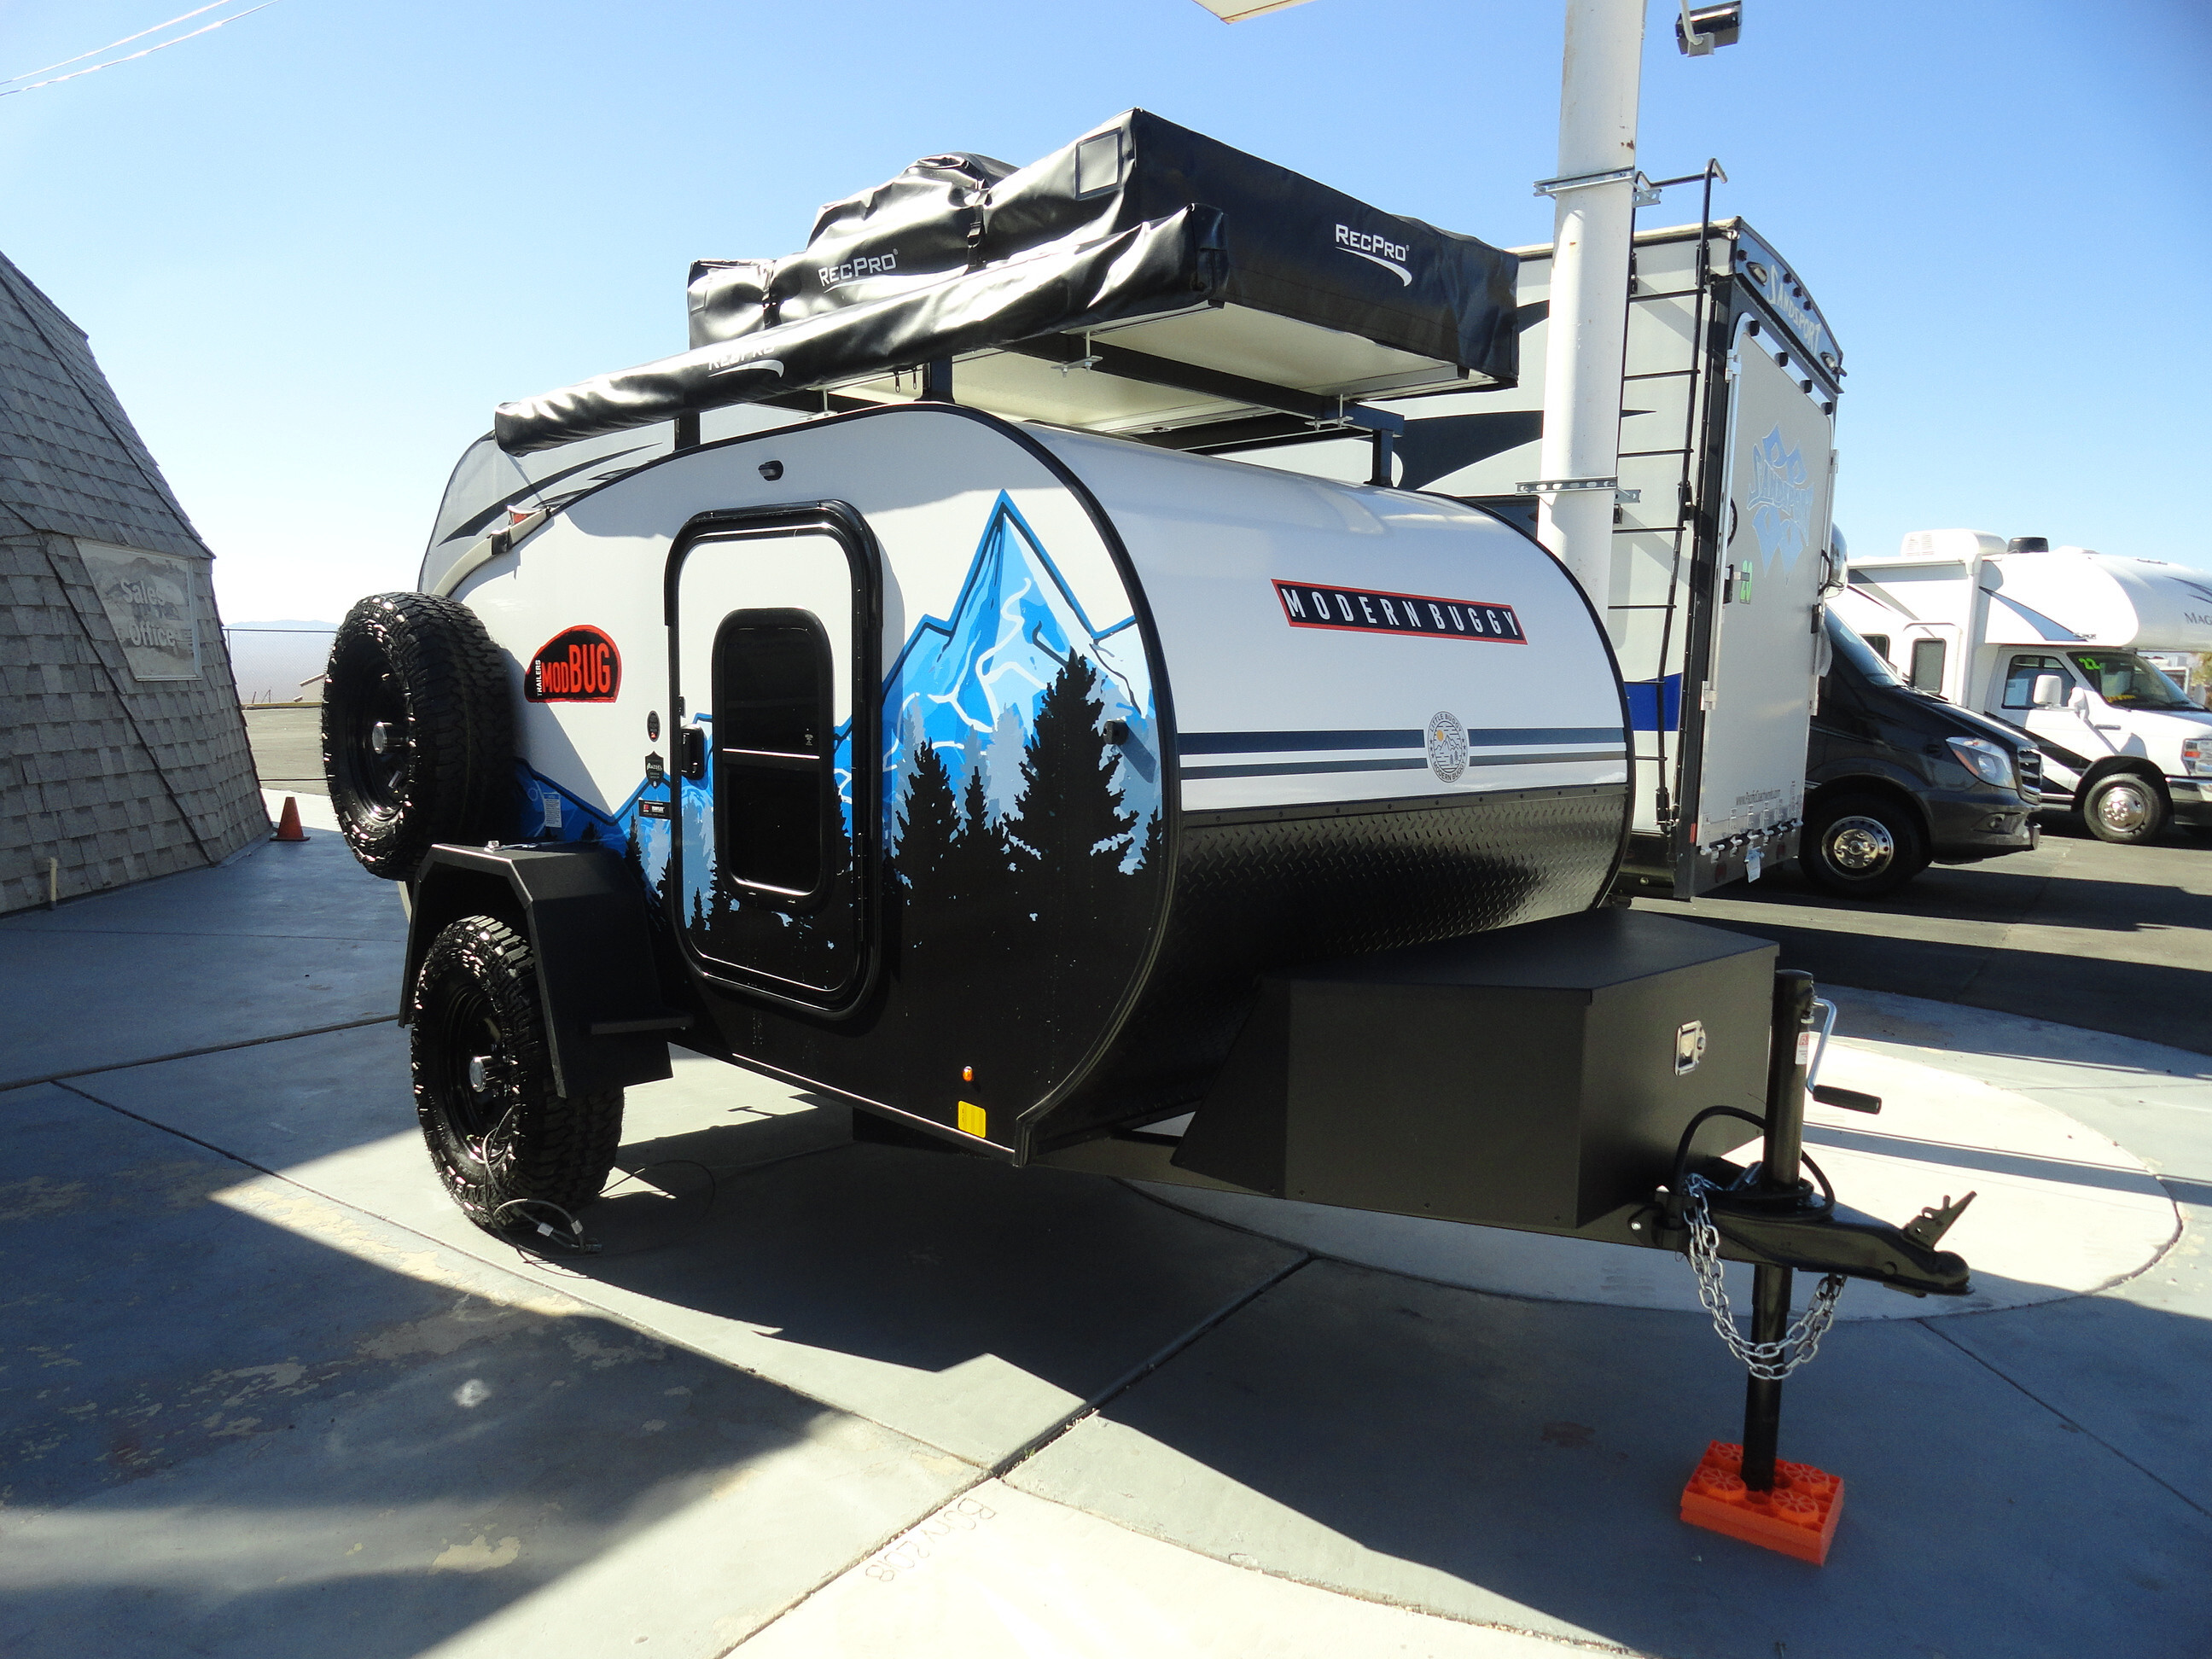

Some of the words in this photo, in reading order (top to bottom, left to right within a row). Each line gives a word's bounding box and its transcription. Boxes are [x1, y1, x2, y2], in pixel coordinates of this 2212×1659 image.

[1767, 264, 1822, 356] SANDSPORT
[119, 579, 166, 606] Sales
[1280, 587, 1423, 628] MODERN
[1428, 602, 1519, 637] BUGGY
[128, 620, 176, 648] Office
[534, 659, 544, 697] TRAILERS
[1429, 713, 1444, 732] LITTLE
[1444, 713, 1462, 732] BUGGY
[1433, 761, 1452, 781] MODERN
[864, 1540, 930, 1582] 2018
